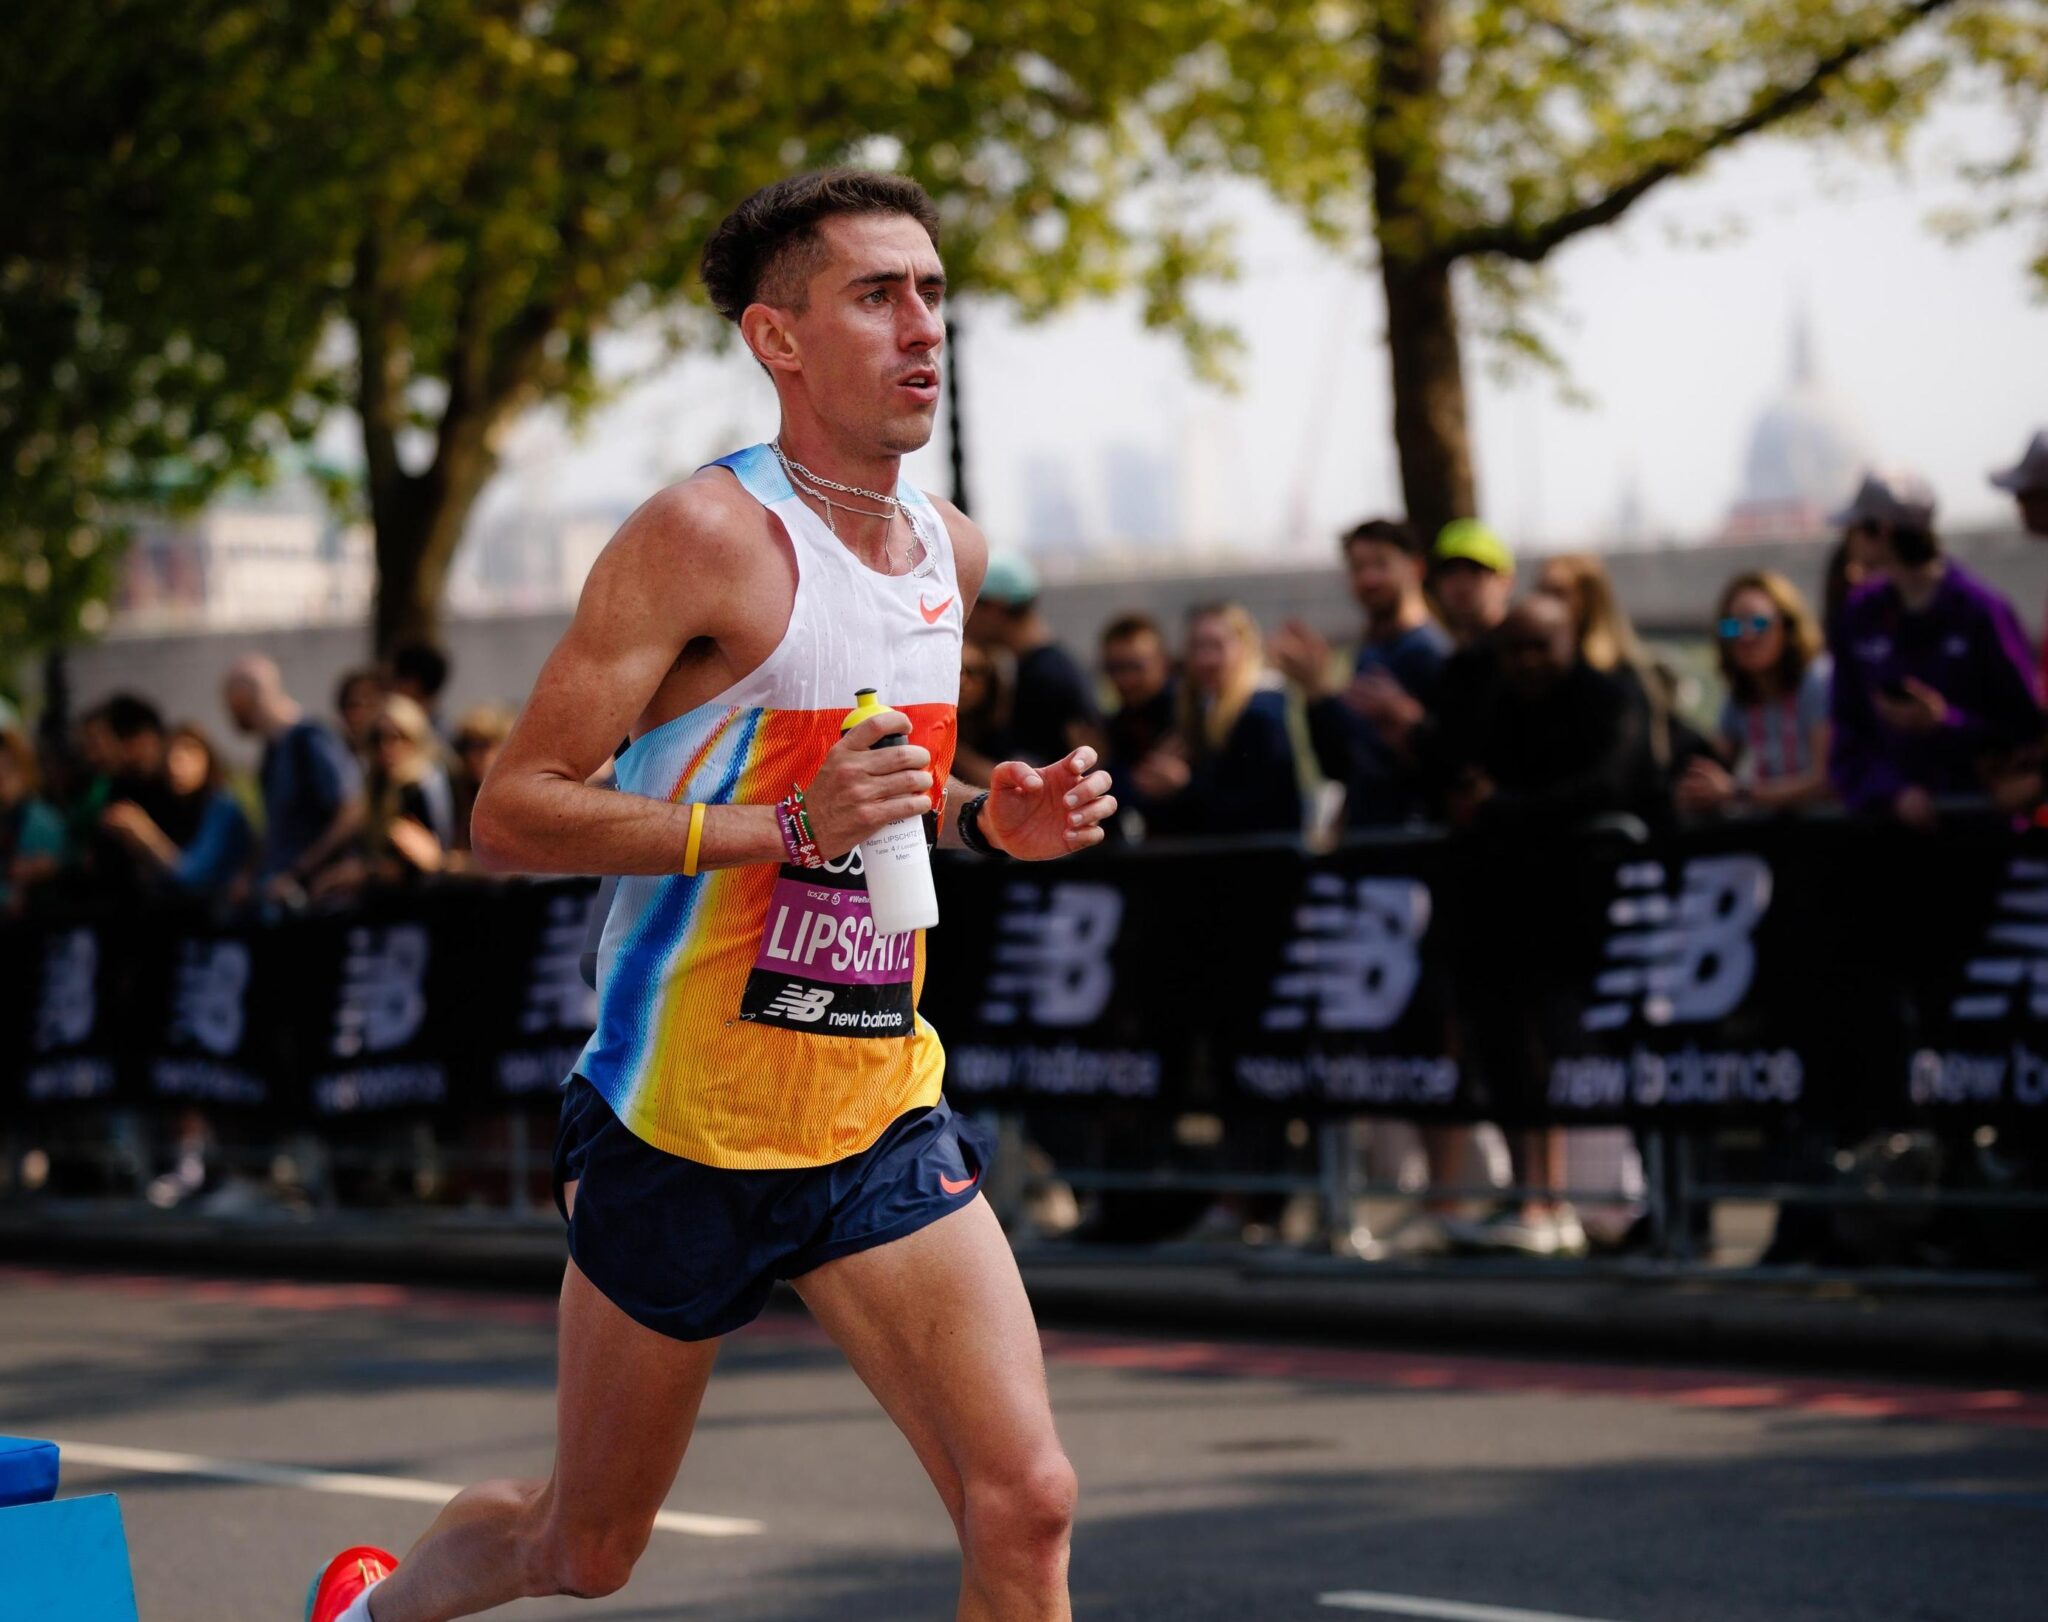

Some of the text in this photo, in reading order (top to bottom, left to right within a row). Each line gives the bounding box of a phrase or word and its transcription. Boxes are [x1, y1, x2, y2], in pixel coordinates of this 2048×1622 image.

[866, 830, 918, 848] Adam LIPSCHITZ
[763, 983, 835, 1023] NB
[828, 1010, 903, 1028] new balance
[1630, 1041, 1804, 1106] balance
